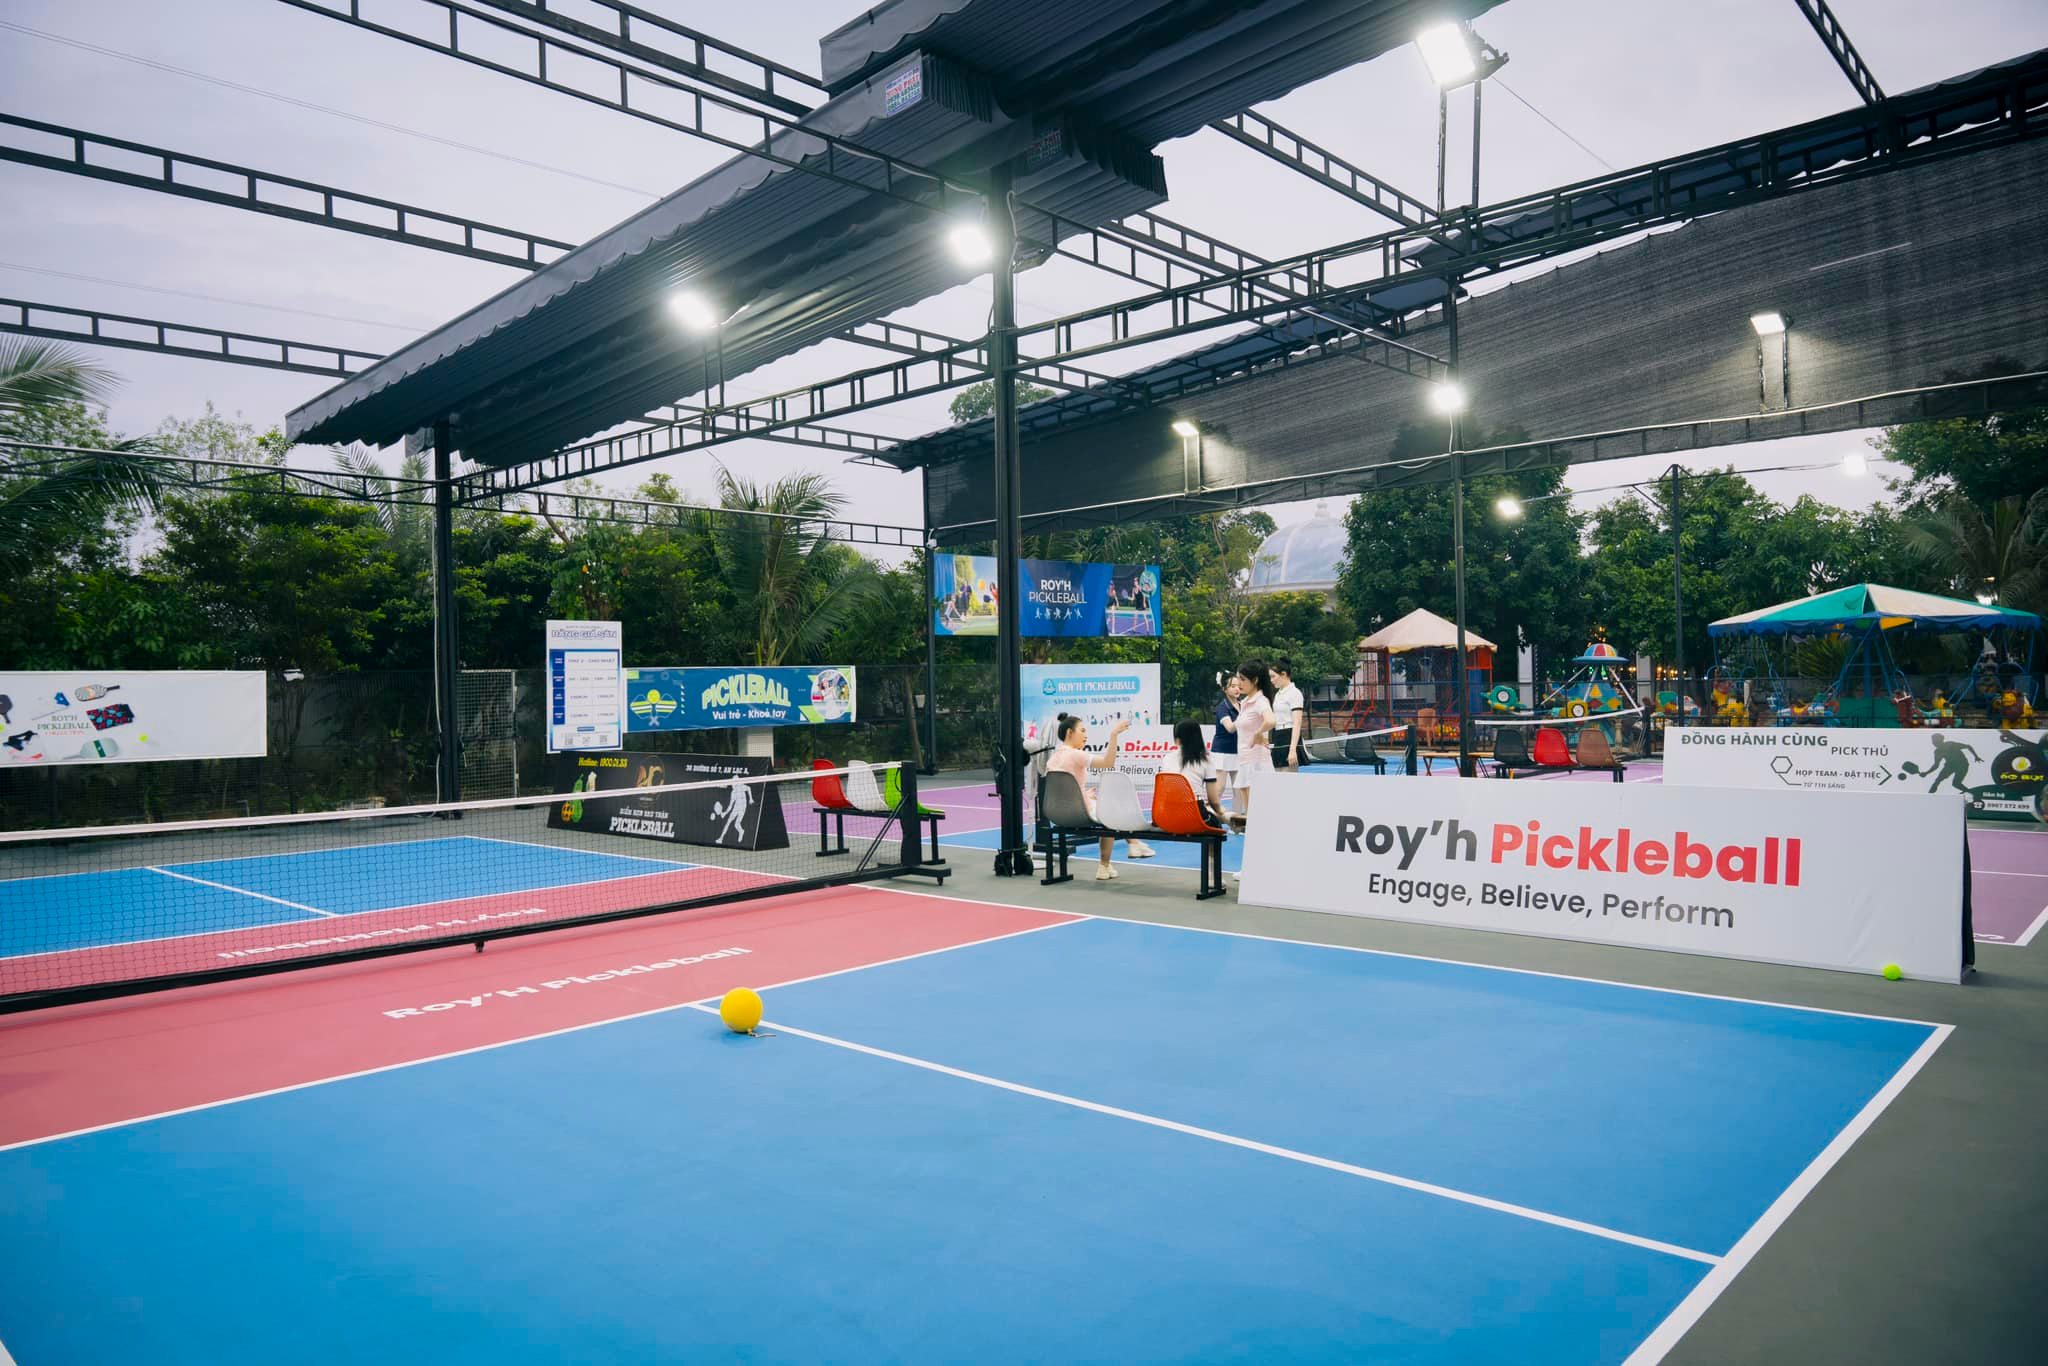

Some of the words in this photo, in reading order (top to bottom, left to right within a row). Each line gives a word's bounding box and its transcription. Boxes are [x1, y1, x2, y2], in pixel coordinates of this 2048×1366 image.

[1040, 579, 1072, 591] ROY'H
[1029, 592, 1088, 604] PICKLEBALL
[712, 710, 726, 720] Vui
[37, 722, 92, 730] PICKLEBALL
[1682, 731, 1726, 745] ĐỒNG
[1730, 732, 1776, 746] HÀNH
[1782, 732, 1828, 746] CÙNG
[1831, 746, 1858, 756] PICK
[1862, 744, 1889, 756] THỦ
[1796, 770, 1813, 778] HỌP
[1815, 770, 1838, 778] TEAM
[1844, 769, 1862, 779] ĐẶT
[1865, 770, 1881, 780] TIỆC
[609, 816, 674, 838] PICKLEBALL
[1334, 815, 1478, 871] Roy'h
[1490, 819, 1801, 887] Pickleball
[1368, 873, 1472, 907] Engage,
[1481, 882, 1592, 919] Believe,
[1602, 893, 1734, 928] Perform
[383, 985, 540, 1020] Roy'H
[540, 947, 752, 990] Pickleball
